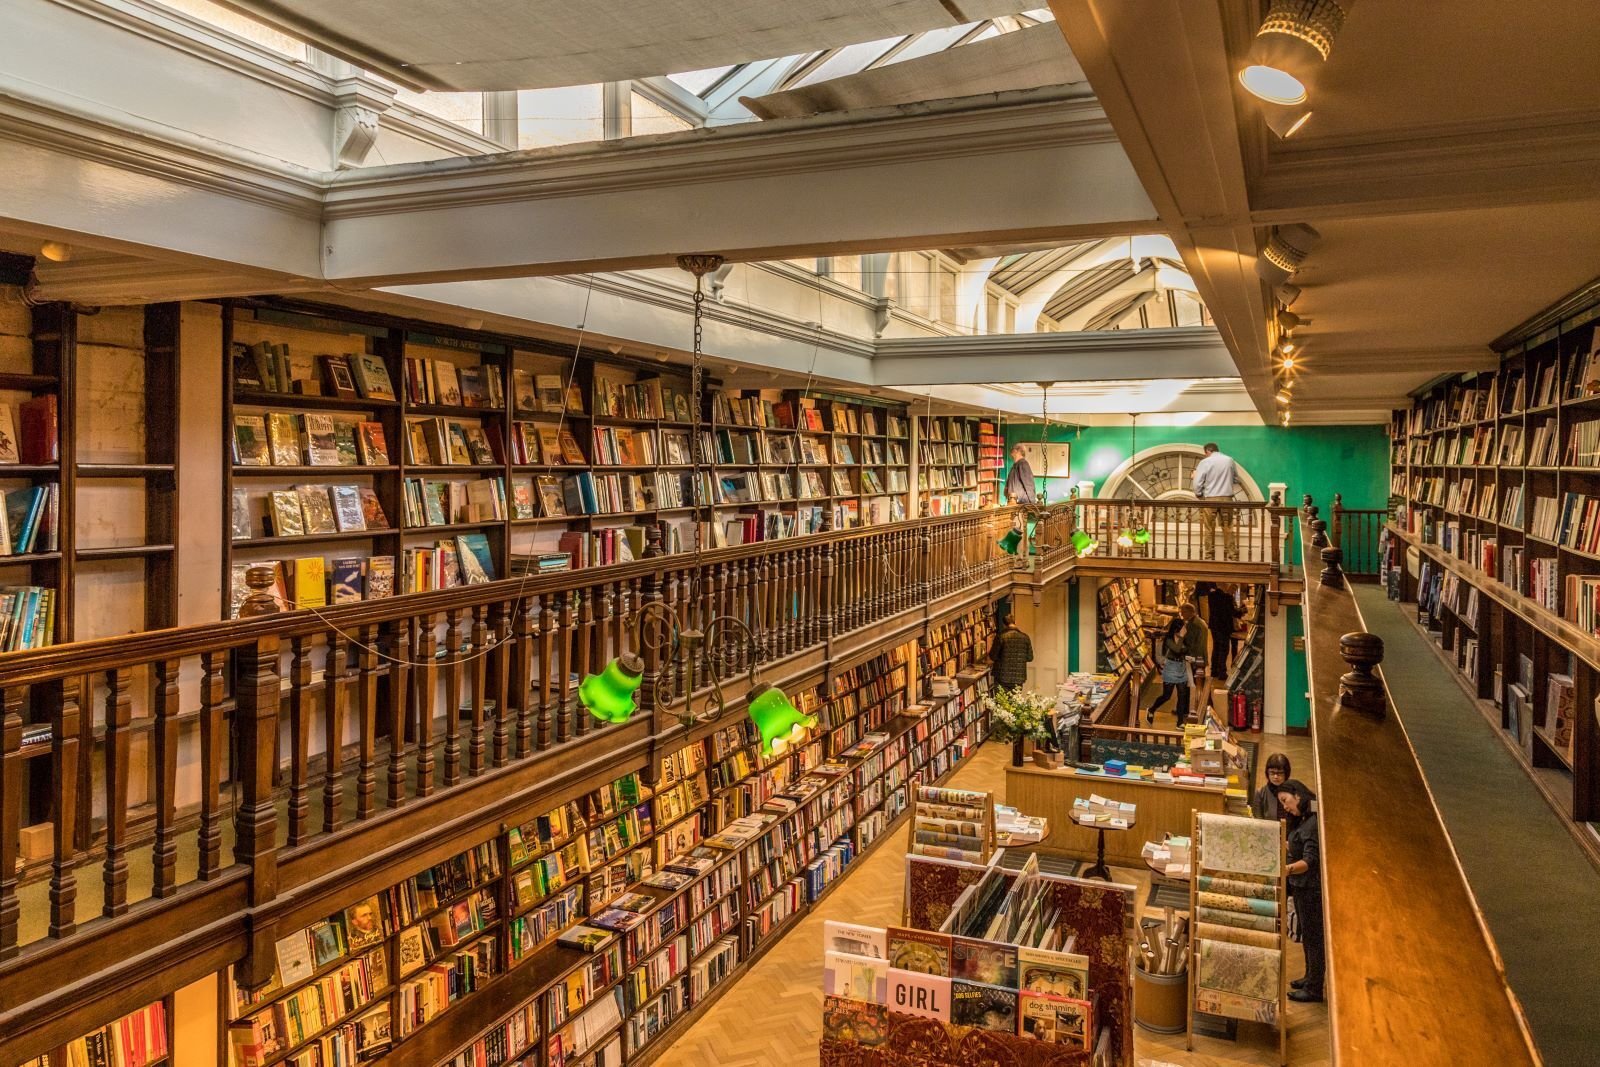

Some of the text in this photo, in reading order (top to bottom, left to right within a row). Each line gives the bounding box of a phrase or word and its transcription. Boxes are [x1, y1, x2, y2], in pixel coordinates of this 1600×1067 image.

[434, 336, 487, 351] NORTH AFRICA
[309, 423, 333, 431] MURPHY
[364, 928, 380, 941] Gogh
[857, 932, 872, 940] YORKER
[954, 944, 1016, 969] SPACE
[896, 983, 940, 1013] GIRL
[1029, 1001, 1043, 1011] dog
[1045, 1003, 1077, 1014] shaming
